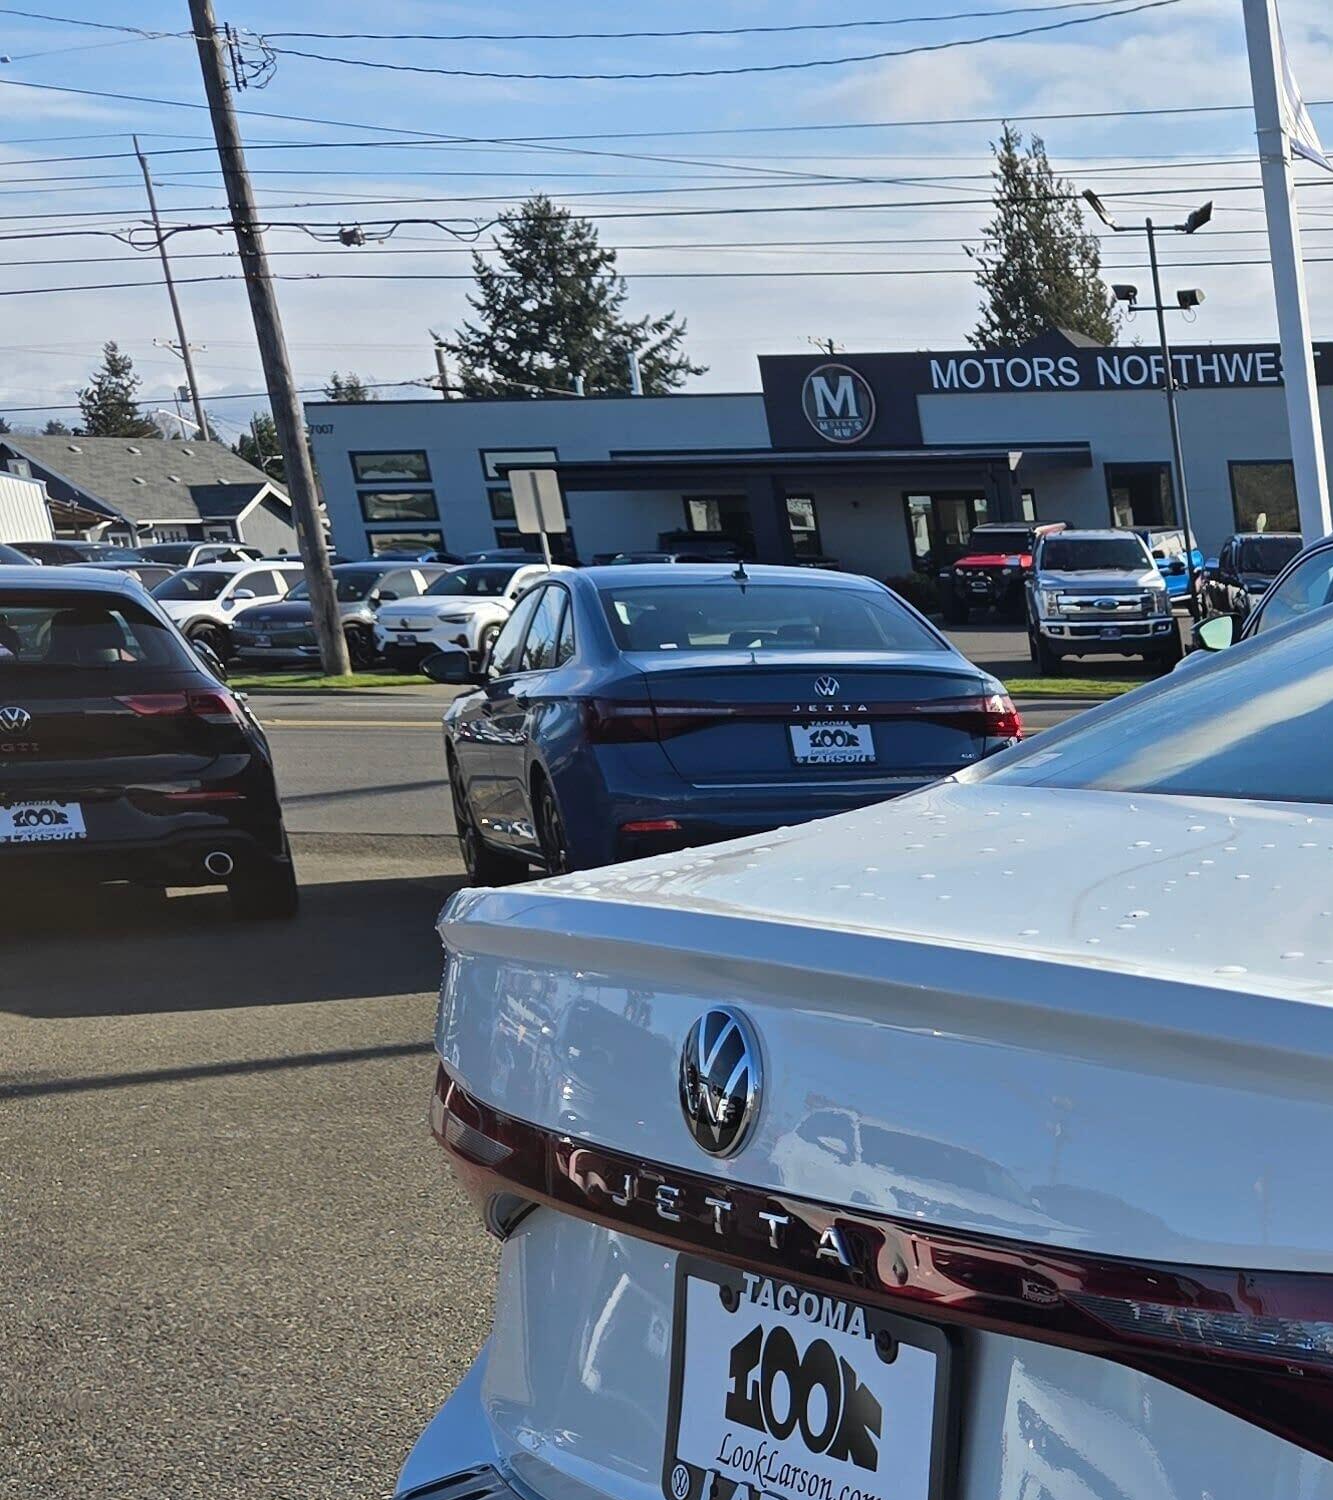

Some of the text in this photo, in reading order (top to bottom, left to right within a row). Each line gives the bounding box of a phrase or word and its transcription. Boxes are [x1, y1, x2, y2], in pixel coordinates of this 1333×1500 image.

[811, 375, 858, 417] M
[930, 351, 1321, 389] MOTORS NORTHWE
[792, 704, 868, 712] JETTA
[612, 1174, 852, 1267] JETTA
[743, 1272, 870, 1340] TACOMA
[725, 1324, 882, 1473] LOOK
